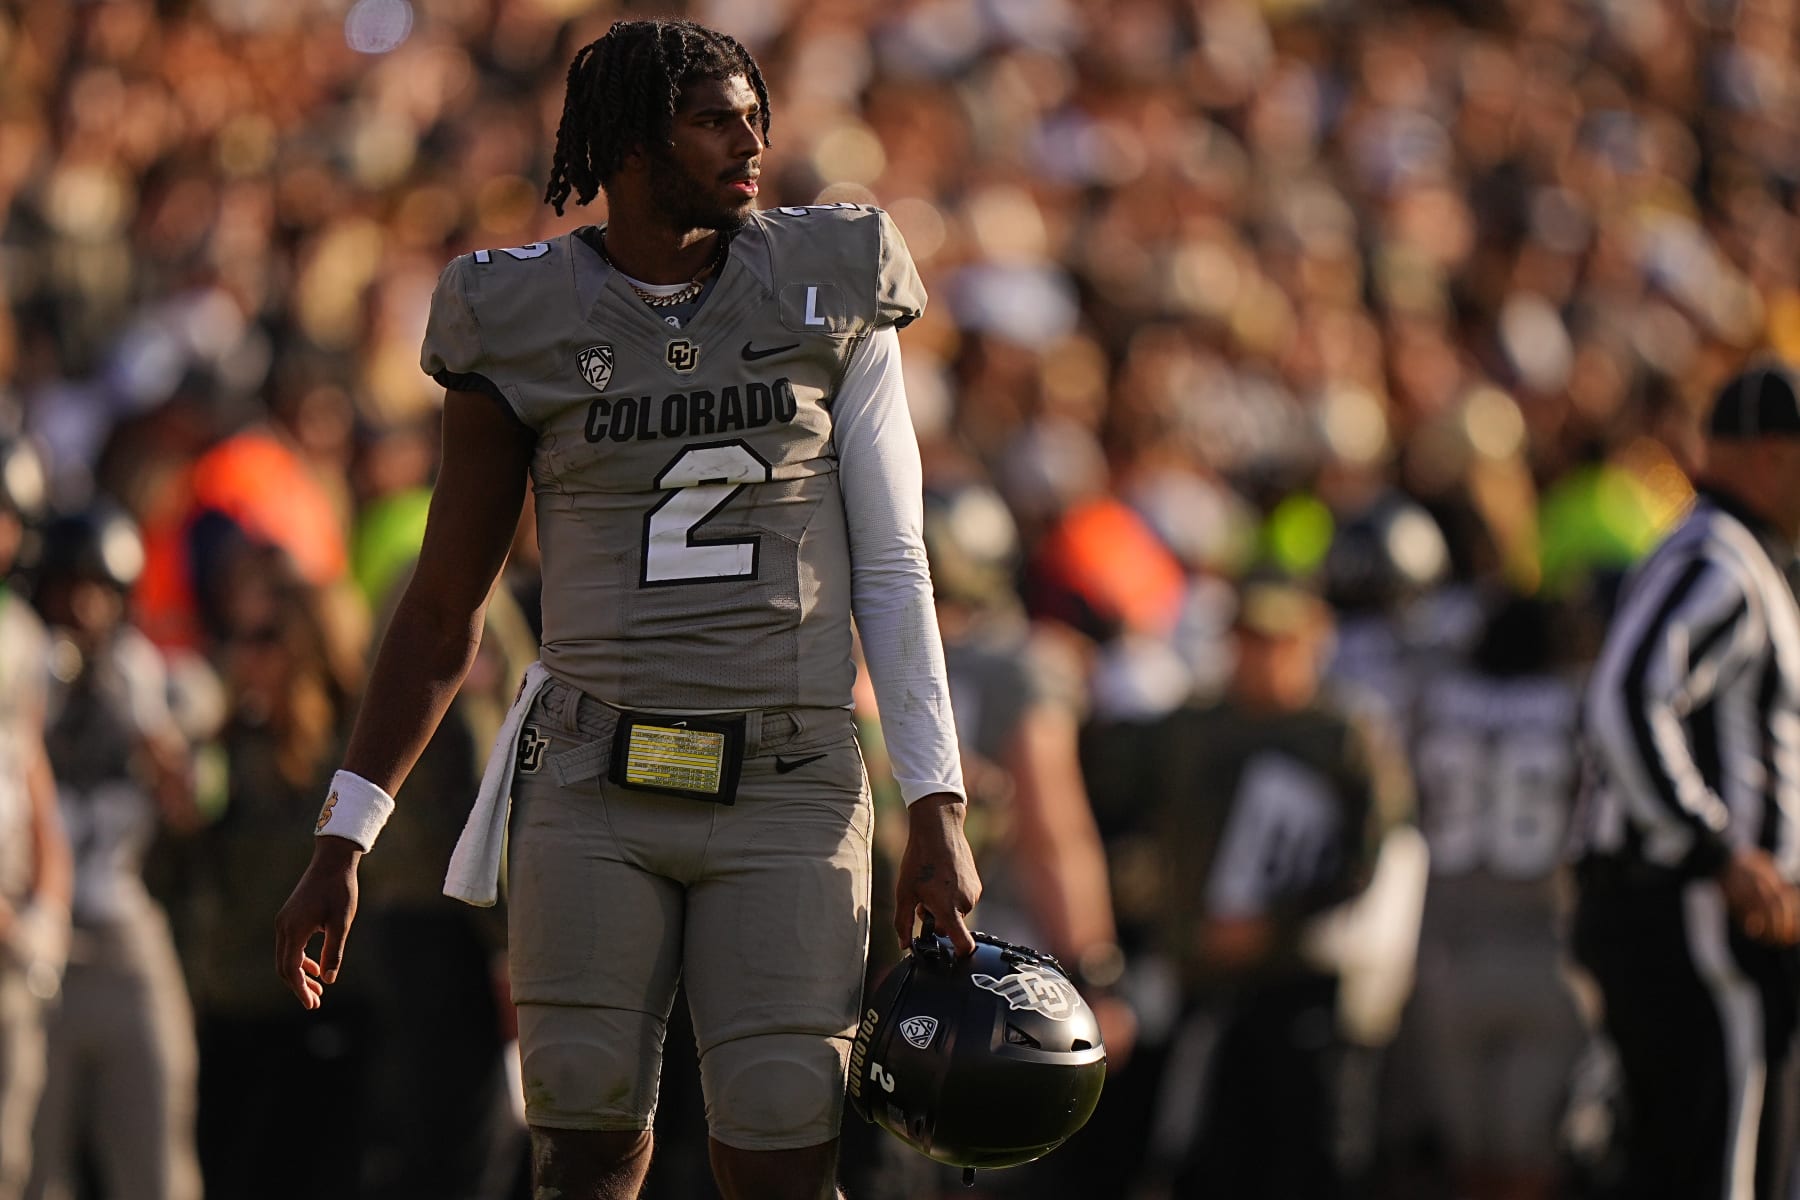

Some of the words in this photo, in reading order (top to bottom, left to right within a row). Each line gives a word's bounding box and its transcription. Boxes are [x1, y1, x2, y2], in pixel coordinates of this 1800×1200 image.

[805, 286, 825, 325] L
[577, 346, 613, 376] PAC
[667, 340, 699, 371] CU
[588, 364, 609, 384] 12
[584, 377, 797, 443] COLORADO
[639, 438, 773, 588] 2
[850, 1008, 879, 1098] COLORADO
[870, 1061, 895, 1093] 2
